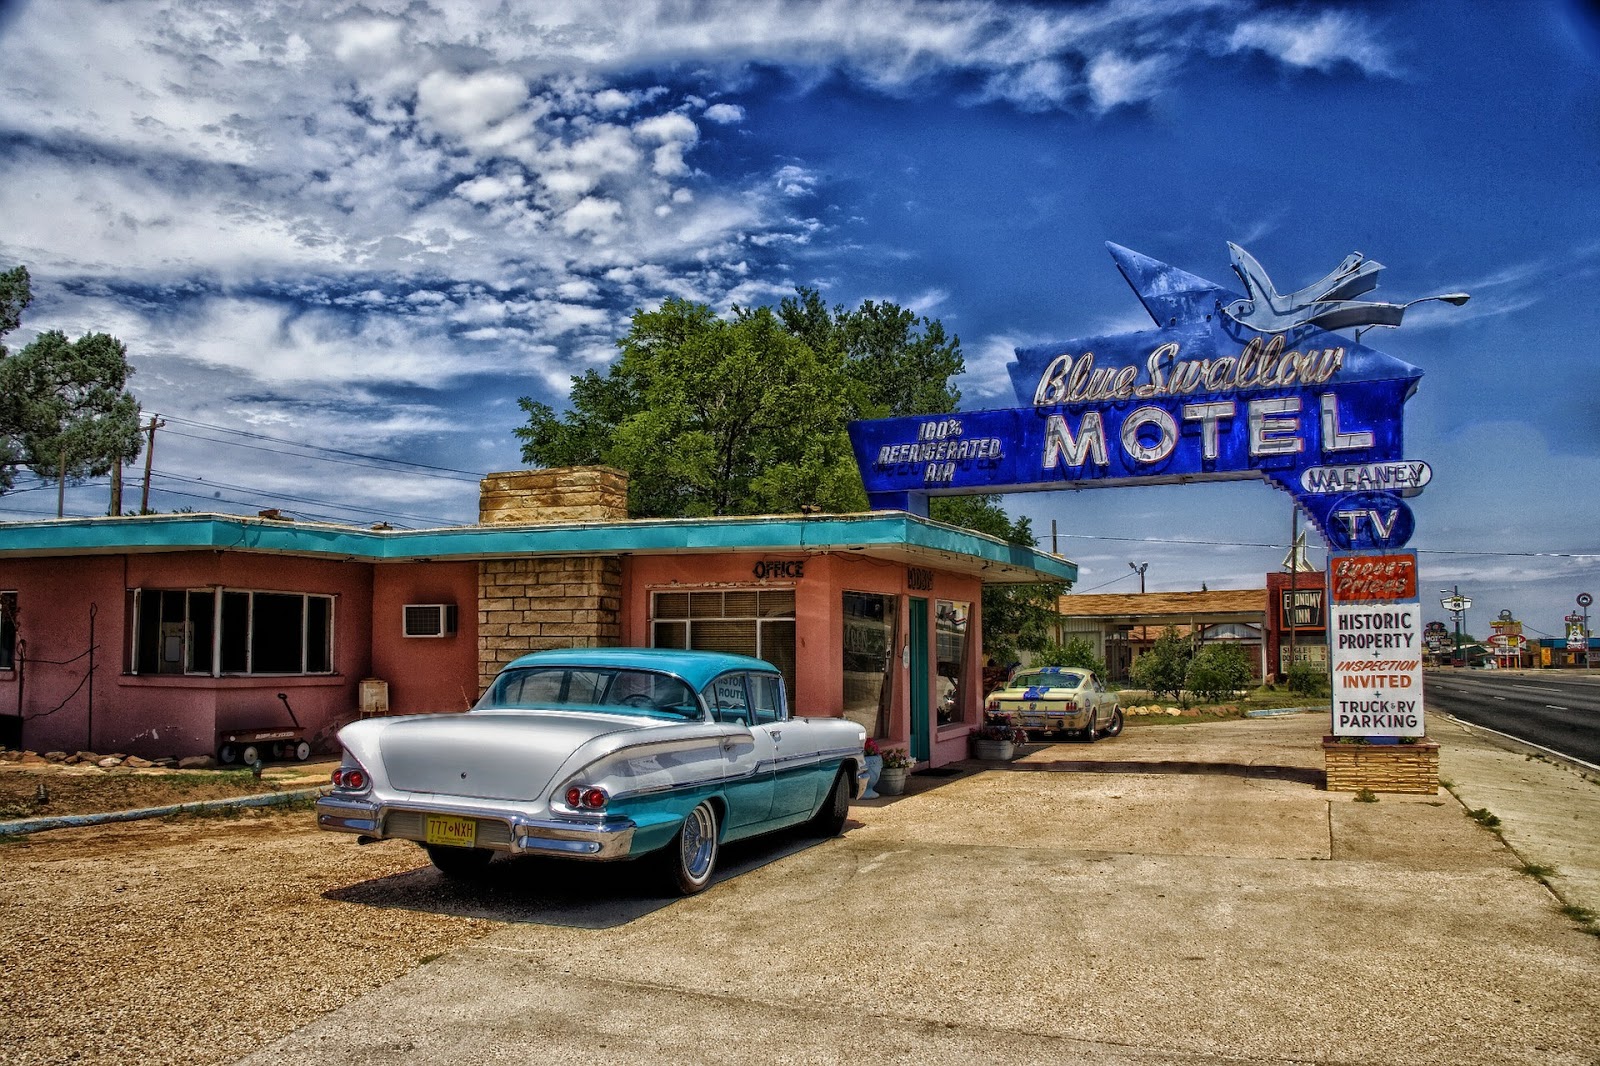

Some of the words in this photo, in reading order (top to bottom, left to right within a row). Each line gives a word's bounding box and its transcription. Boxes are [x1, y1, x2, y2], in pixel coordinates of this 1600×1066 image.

[1033, 351, 1138, 405] Blue
[1135, 335, 1344, 397] Swallow
[918, 419, 963, 440] 100%
[1042, 392, 1375, 469] MOTEL
[878, 437, 1002, 464] REFRIGERATED
[924, 462, 957, 481] AIR
[1335, 509, 1398, 541] TV
[754, 561, 804, 578] OFFICE
[1284, 593, 1322, 609] EONOMY
[1295, 609, 1311, 623] INN
[1338, 613, 1412, 630] HISTORIC
[1338, 633, 1414, 649] PROPERTY
[1335, 660, 1420, 672] INSPECTION
[1343, 674, 1412, 688] INVITED
[718, 687, 744, 699] ROUTE
[1339, 701, 1389, 713] TRUCK
[1397, 701, 1416, 713] RV
[1340, 715, 1418, 728] PARKING
